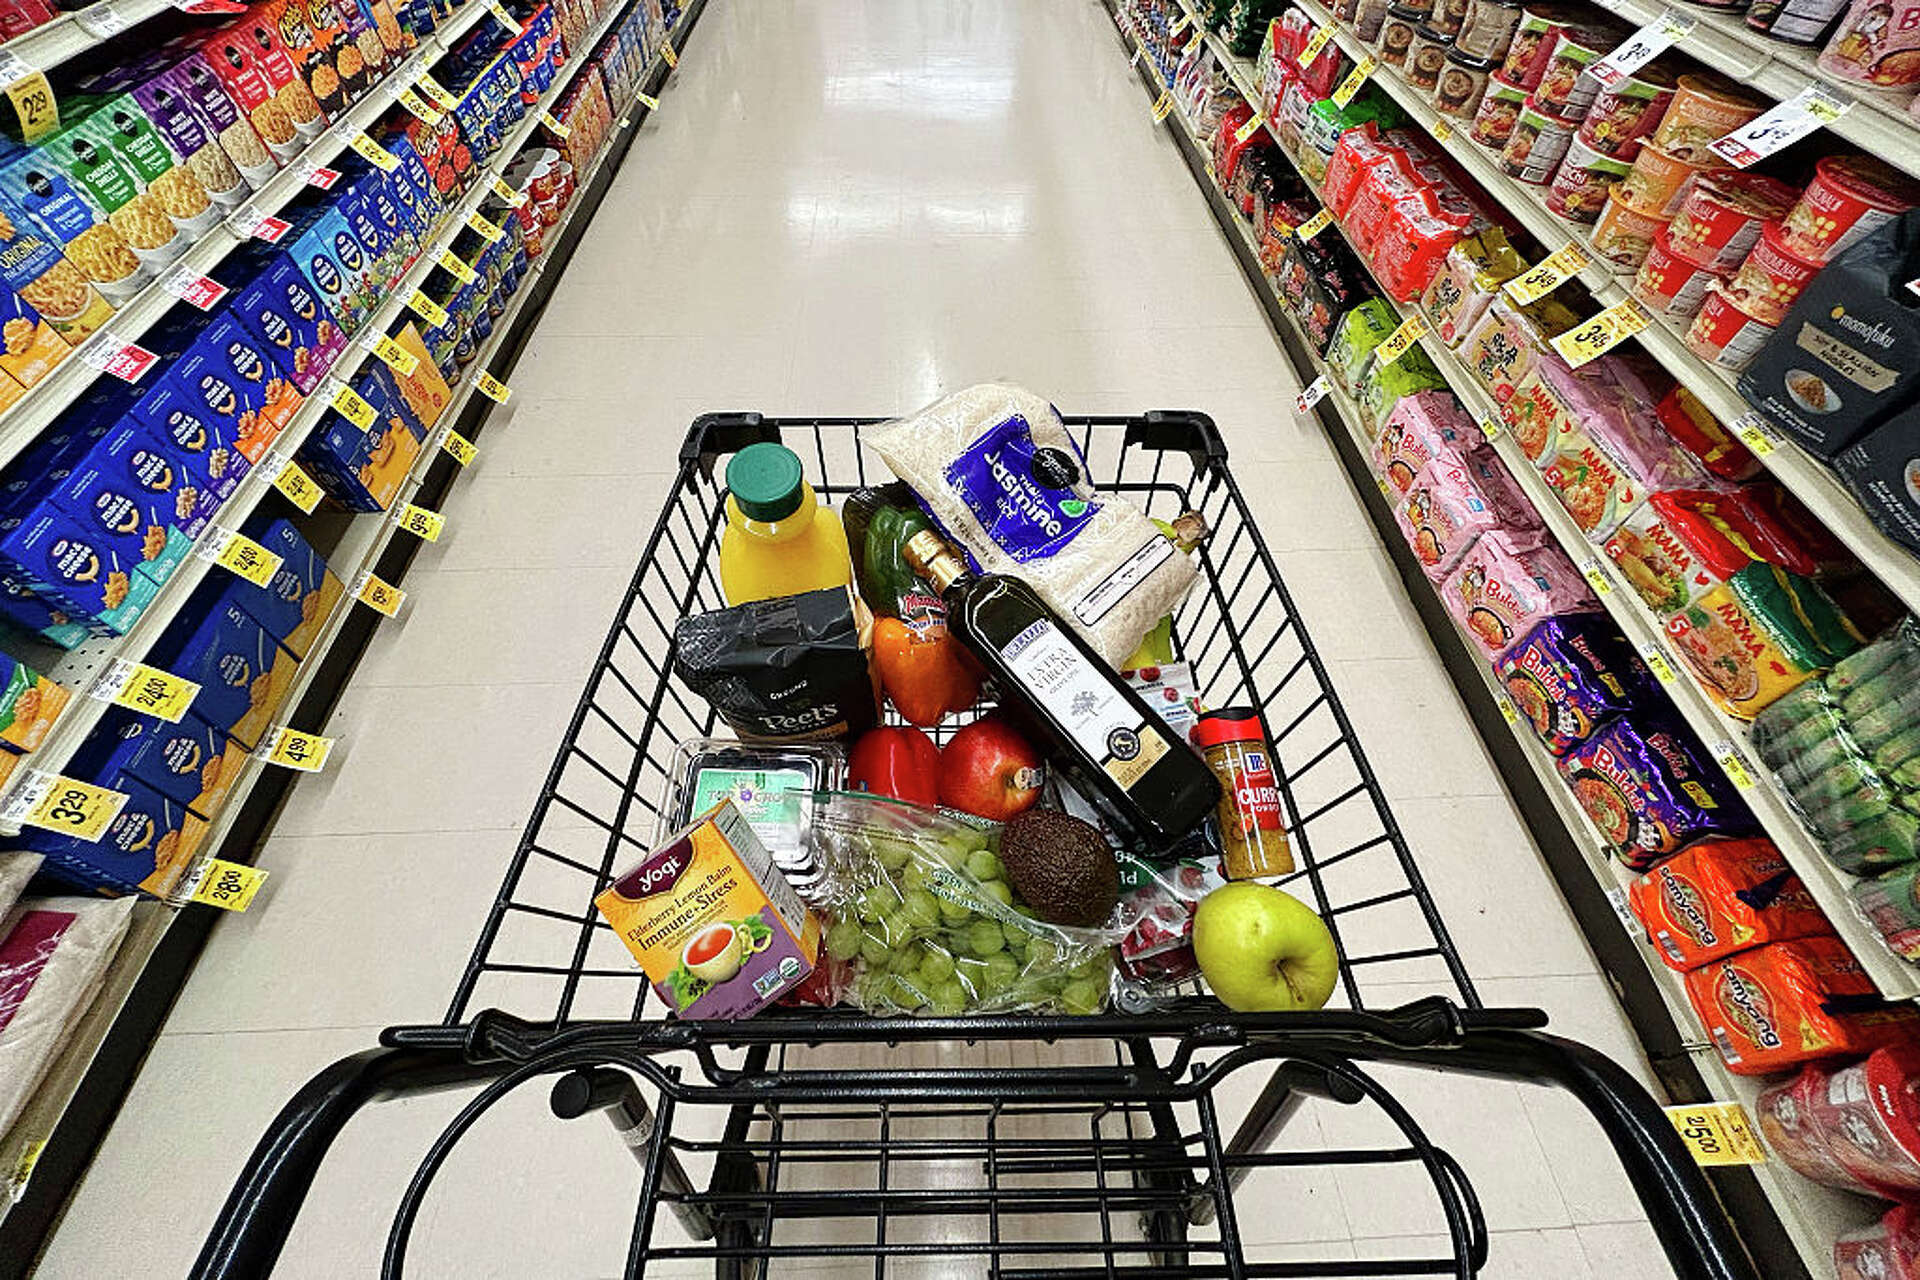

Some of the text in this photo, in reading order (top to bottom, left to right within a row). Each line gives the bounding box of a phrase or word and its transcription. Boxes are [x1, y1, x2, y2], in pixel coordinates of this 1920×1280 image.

[1839, 315, 1895, 348] momofuku
[1530, 384, 1558, 422] MAMA
[1580, 448, 1616, 488] MAMA
[984, 450, 1062, 537] Jasmine
[1646, 523, 1692, 572] MAMA
[1668, 618, 1686, 633] 5
[1717, 603, 1766, 658] MAMA
[1026, 646, 1068, 681] EXTRA
[1034, 654, 1078, 689] VIRGIN
[287, 736, 309, 762] 499
[50, 790, 88, 825] 329
[1239, 787, 1278, 805] CURR
[638, 856, 682, 892] yogi
[628, 904, 676, 943] Elderberry
[675, 880, 708, 908] Lemon
[706, 864, 732, 889] Balm
[1660, 867, 1718, 948] samyang
[1721, 962, 1781, 1048] amyang
